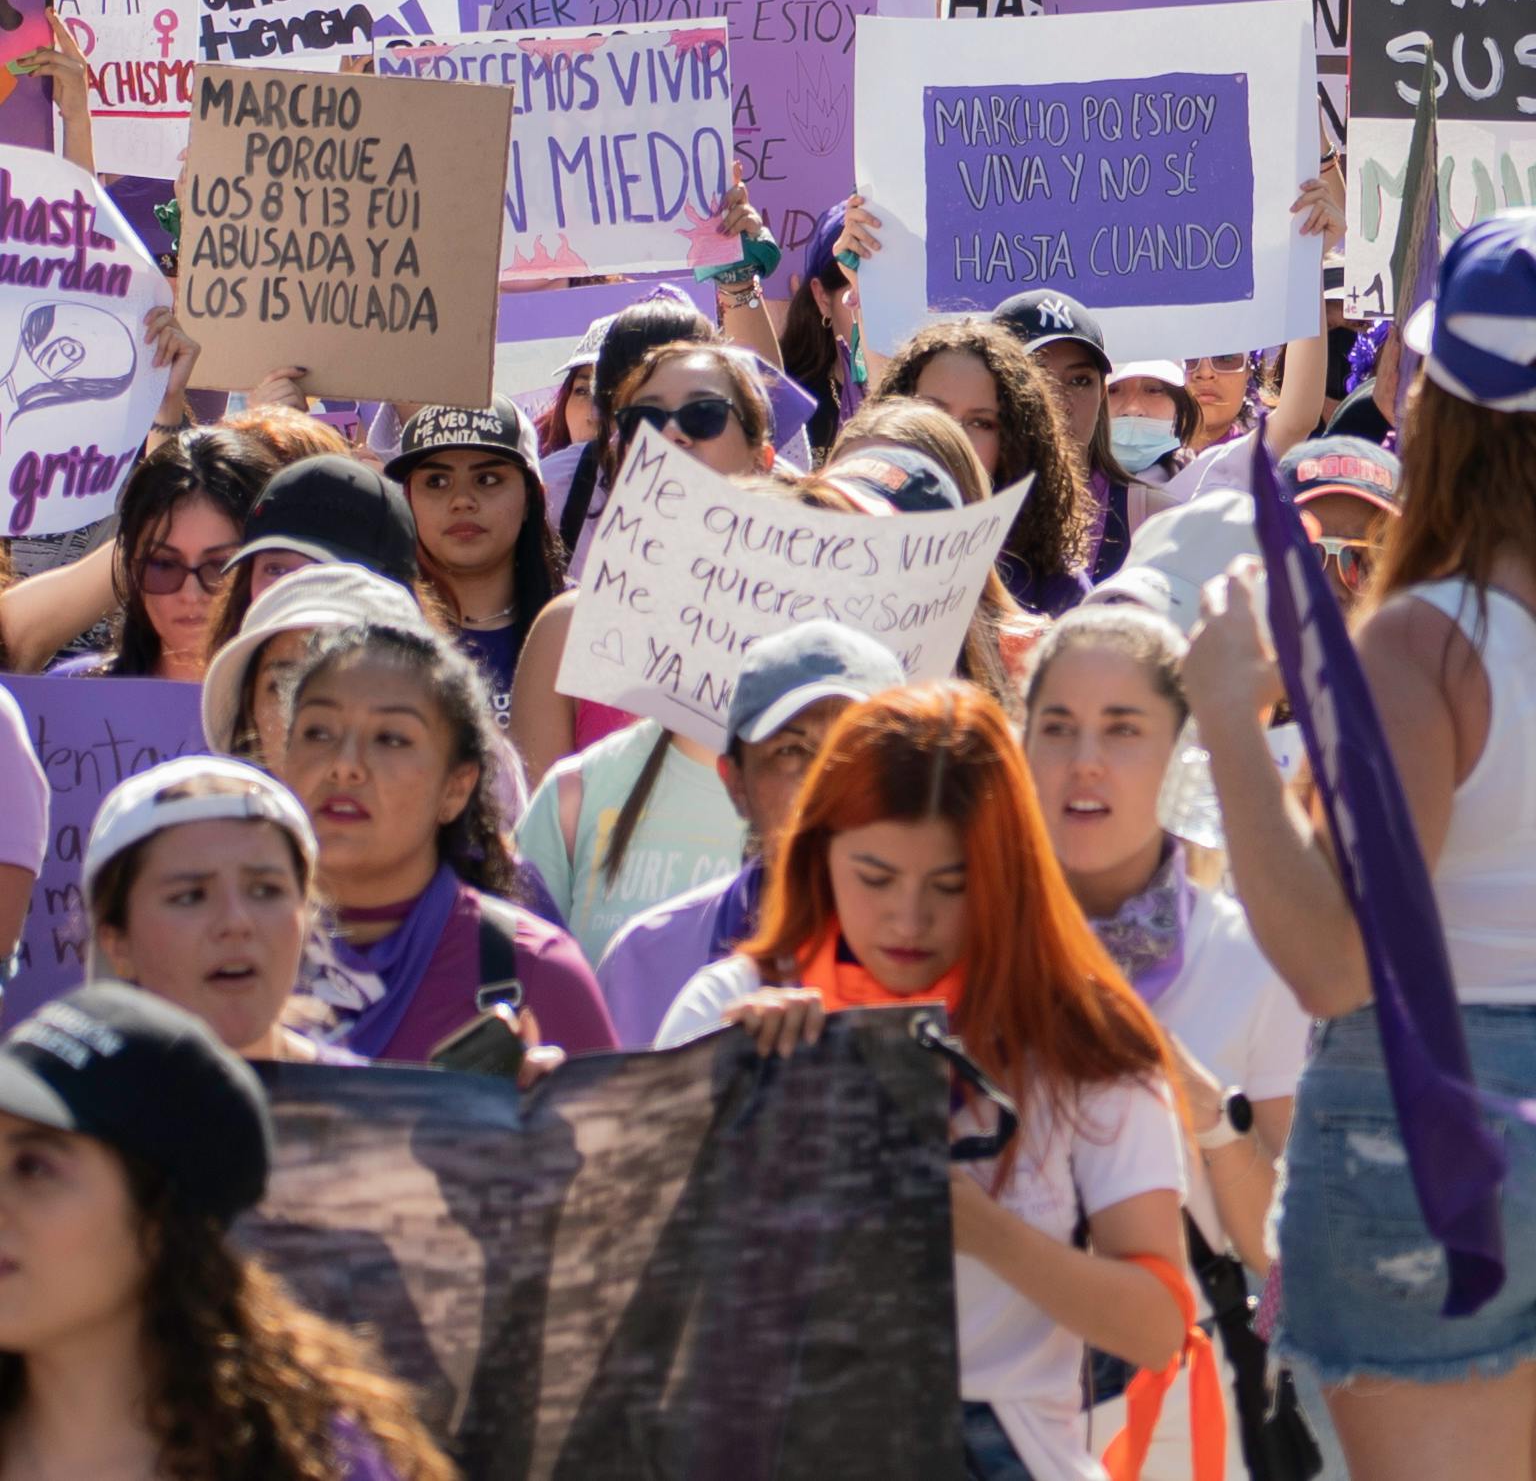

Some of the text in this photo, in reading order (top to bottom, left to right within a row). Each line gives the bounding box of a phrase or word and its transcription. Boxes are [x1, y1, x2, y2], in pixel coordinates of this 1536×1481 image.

[606, 39, 730, 107] VIVIR
[200, 76, 362, 131] MARCHO
[934, 92, 1217, 147] MARCHO PQ ESTOY
[245, 132, 418, 187] PORQUE A
[547, 126, 728, 230] MIEDO
[958, 139, 1198, 211] VIVA Y NO SÉ
[191, 174, 421, 232] LOS 8 Y 13 FUI
[191, 223, 420, 279] ABUSADA Y A
[954, 221, 1243, 284] HASTA CUANDO
[186, 274, 439, 335] LOS 15 VIOLADA
[1037, 298, 1074, 329] NY
[438, 411, 468, 429] VEO
